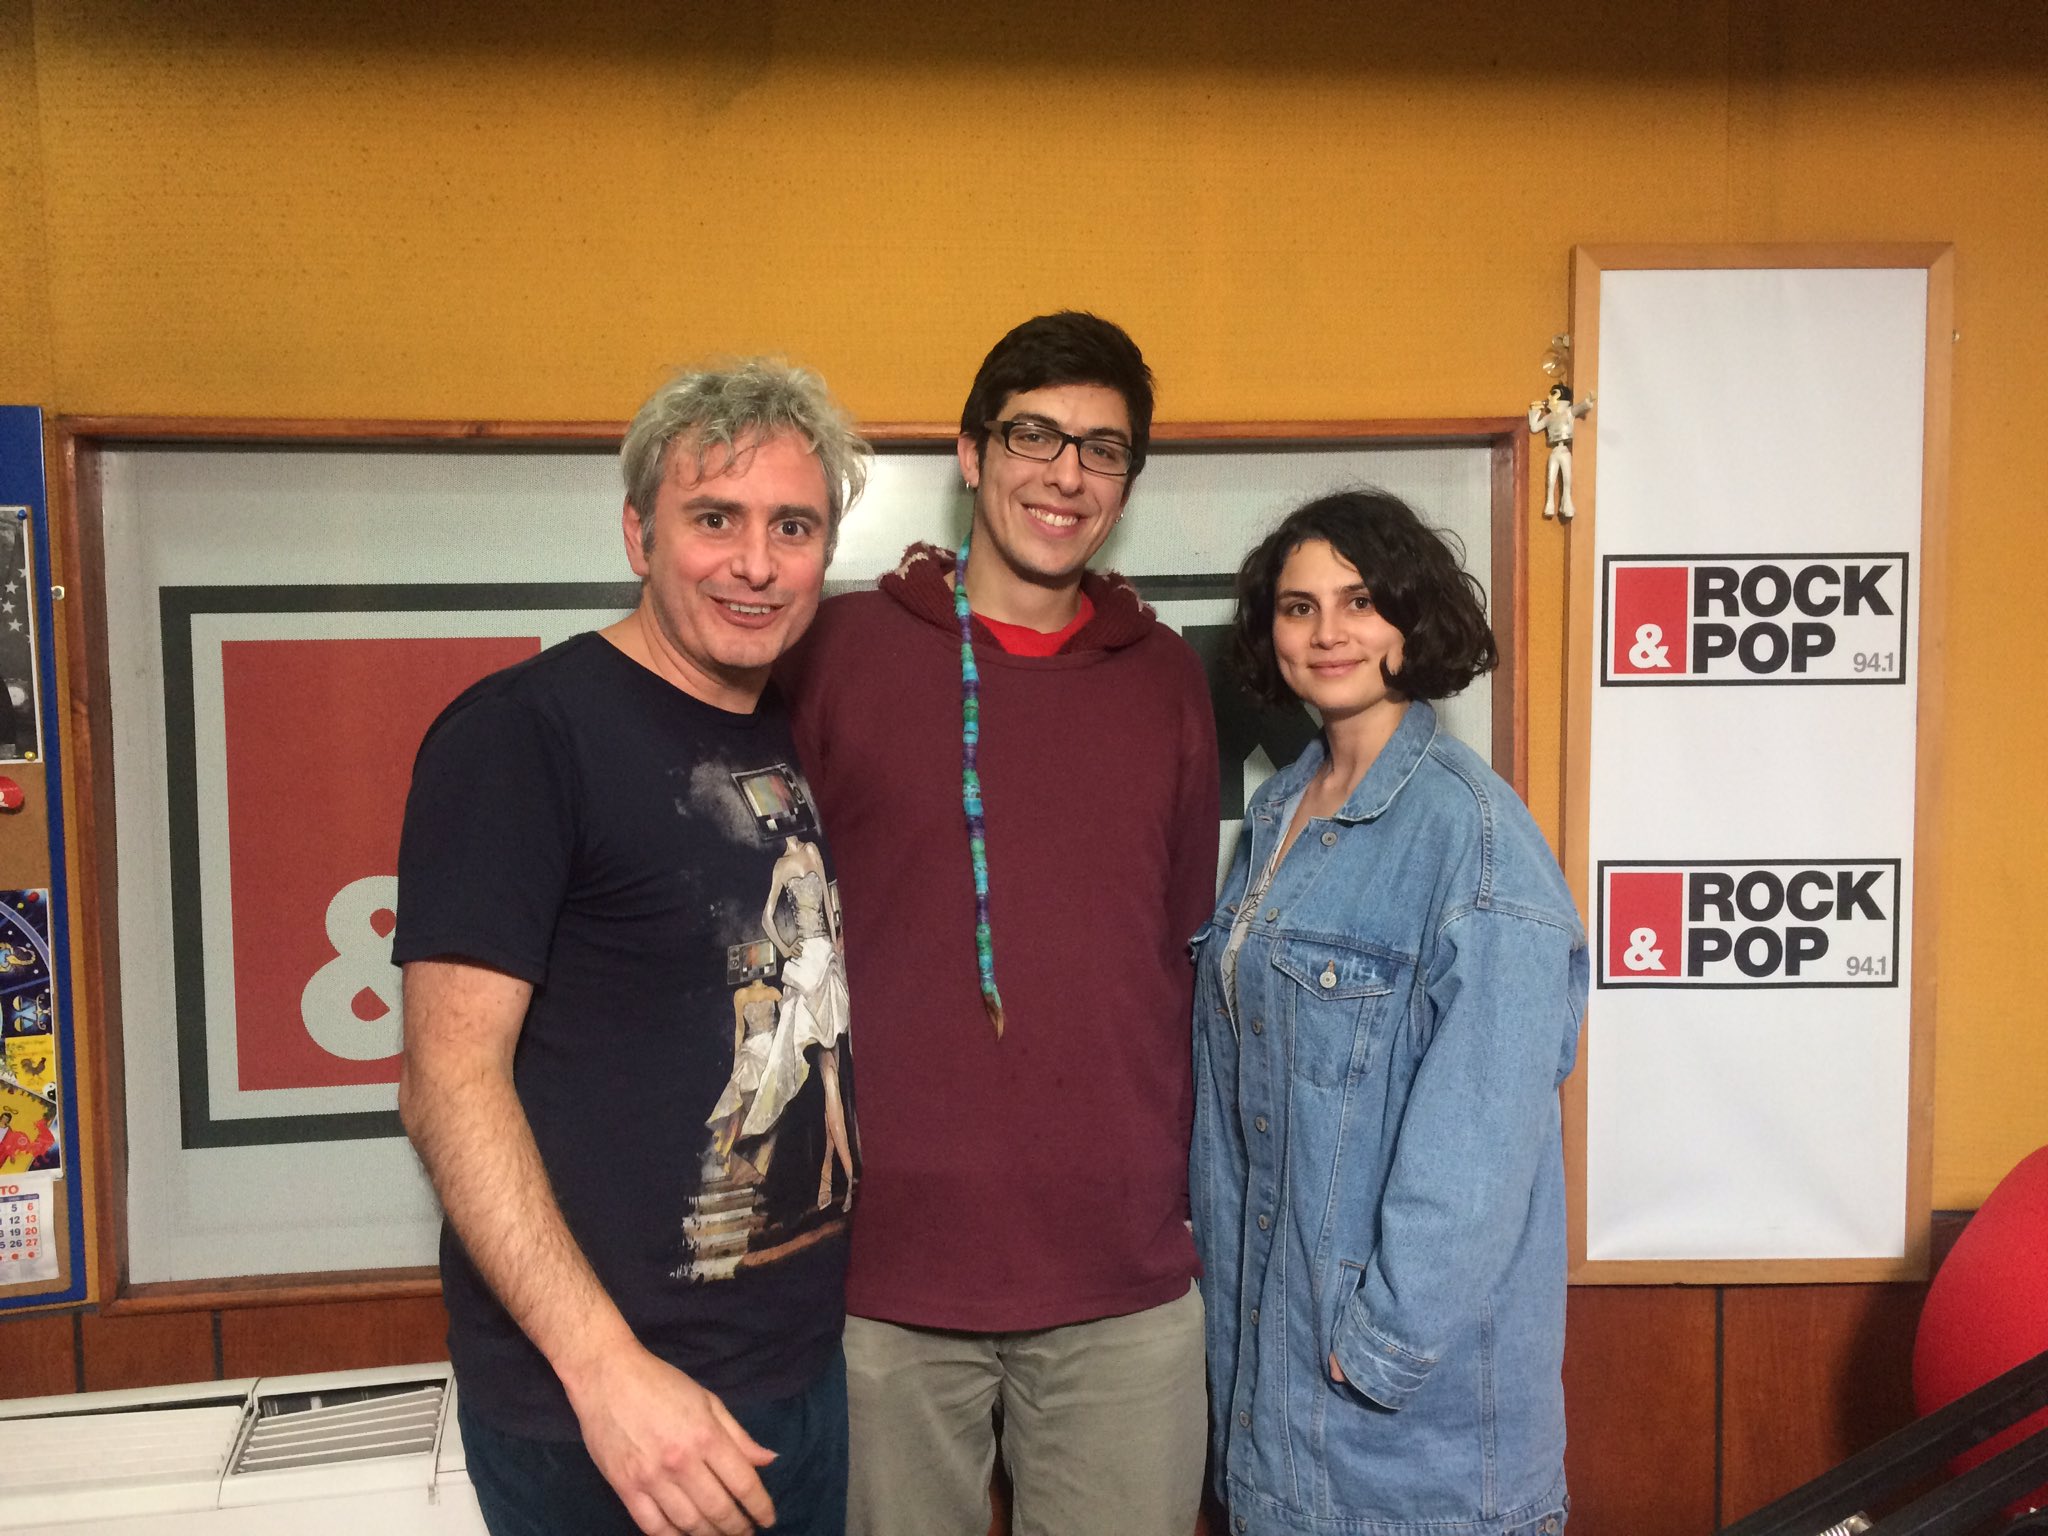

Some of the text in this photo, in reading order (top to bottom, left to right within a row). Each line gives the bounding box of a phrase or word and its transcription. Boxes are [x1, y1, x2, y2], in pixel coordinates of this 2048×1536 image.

[1693, 564, 1894, 617] ROCK
[1628, 621, 1894, 674] & POP 94.1
[1688, 870, 1887, 922] ROCK
[1623, 926, 1887, 978] & POP 94.1
[9, 1216, 20, 1224] 12
[25, 1214, 37, 1223] 13
[11, 1202, 34, 1212] 5 6
[9, 1228, 21, 1236] 19
[25, 1226, 38, 1235] 20
[9, 1240, 22, 1248] 26
[25, 1238, 38, 1247] 27
